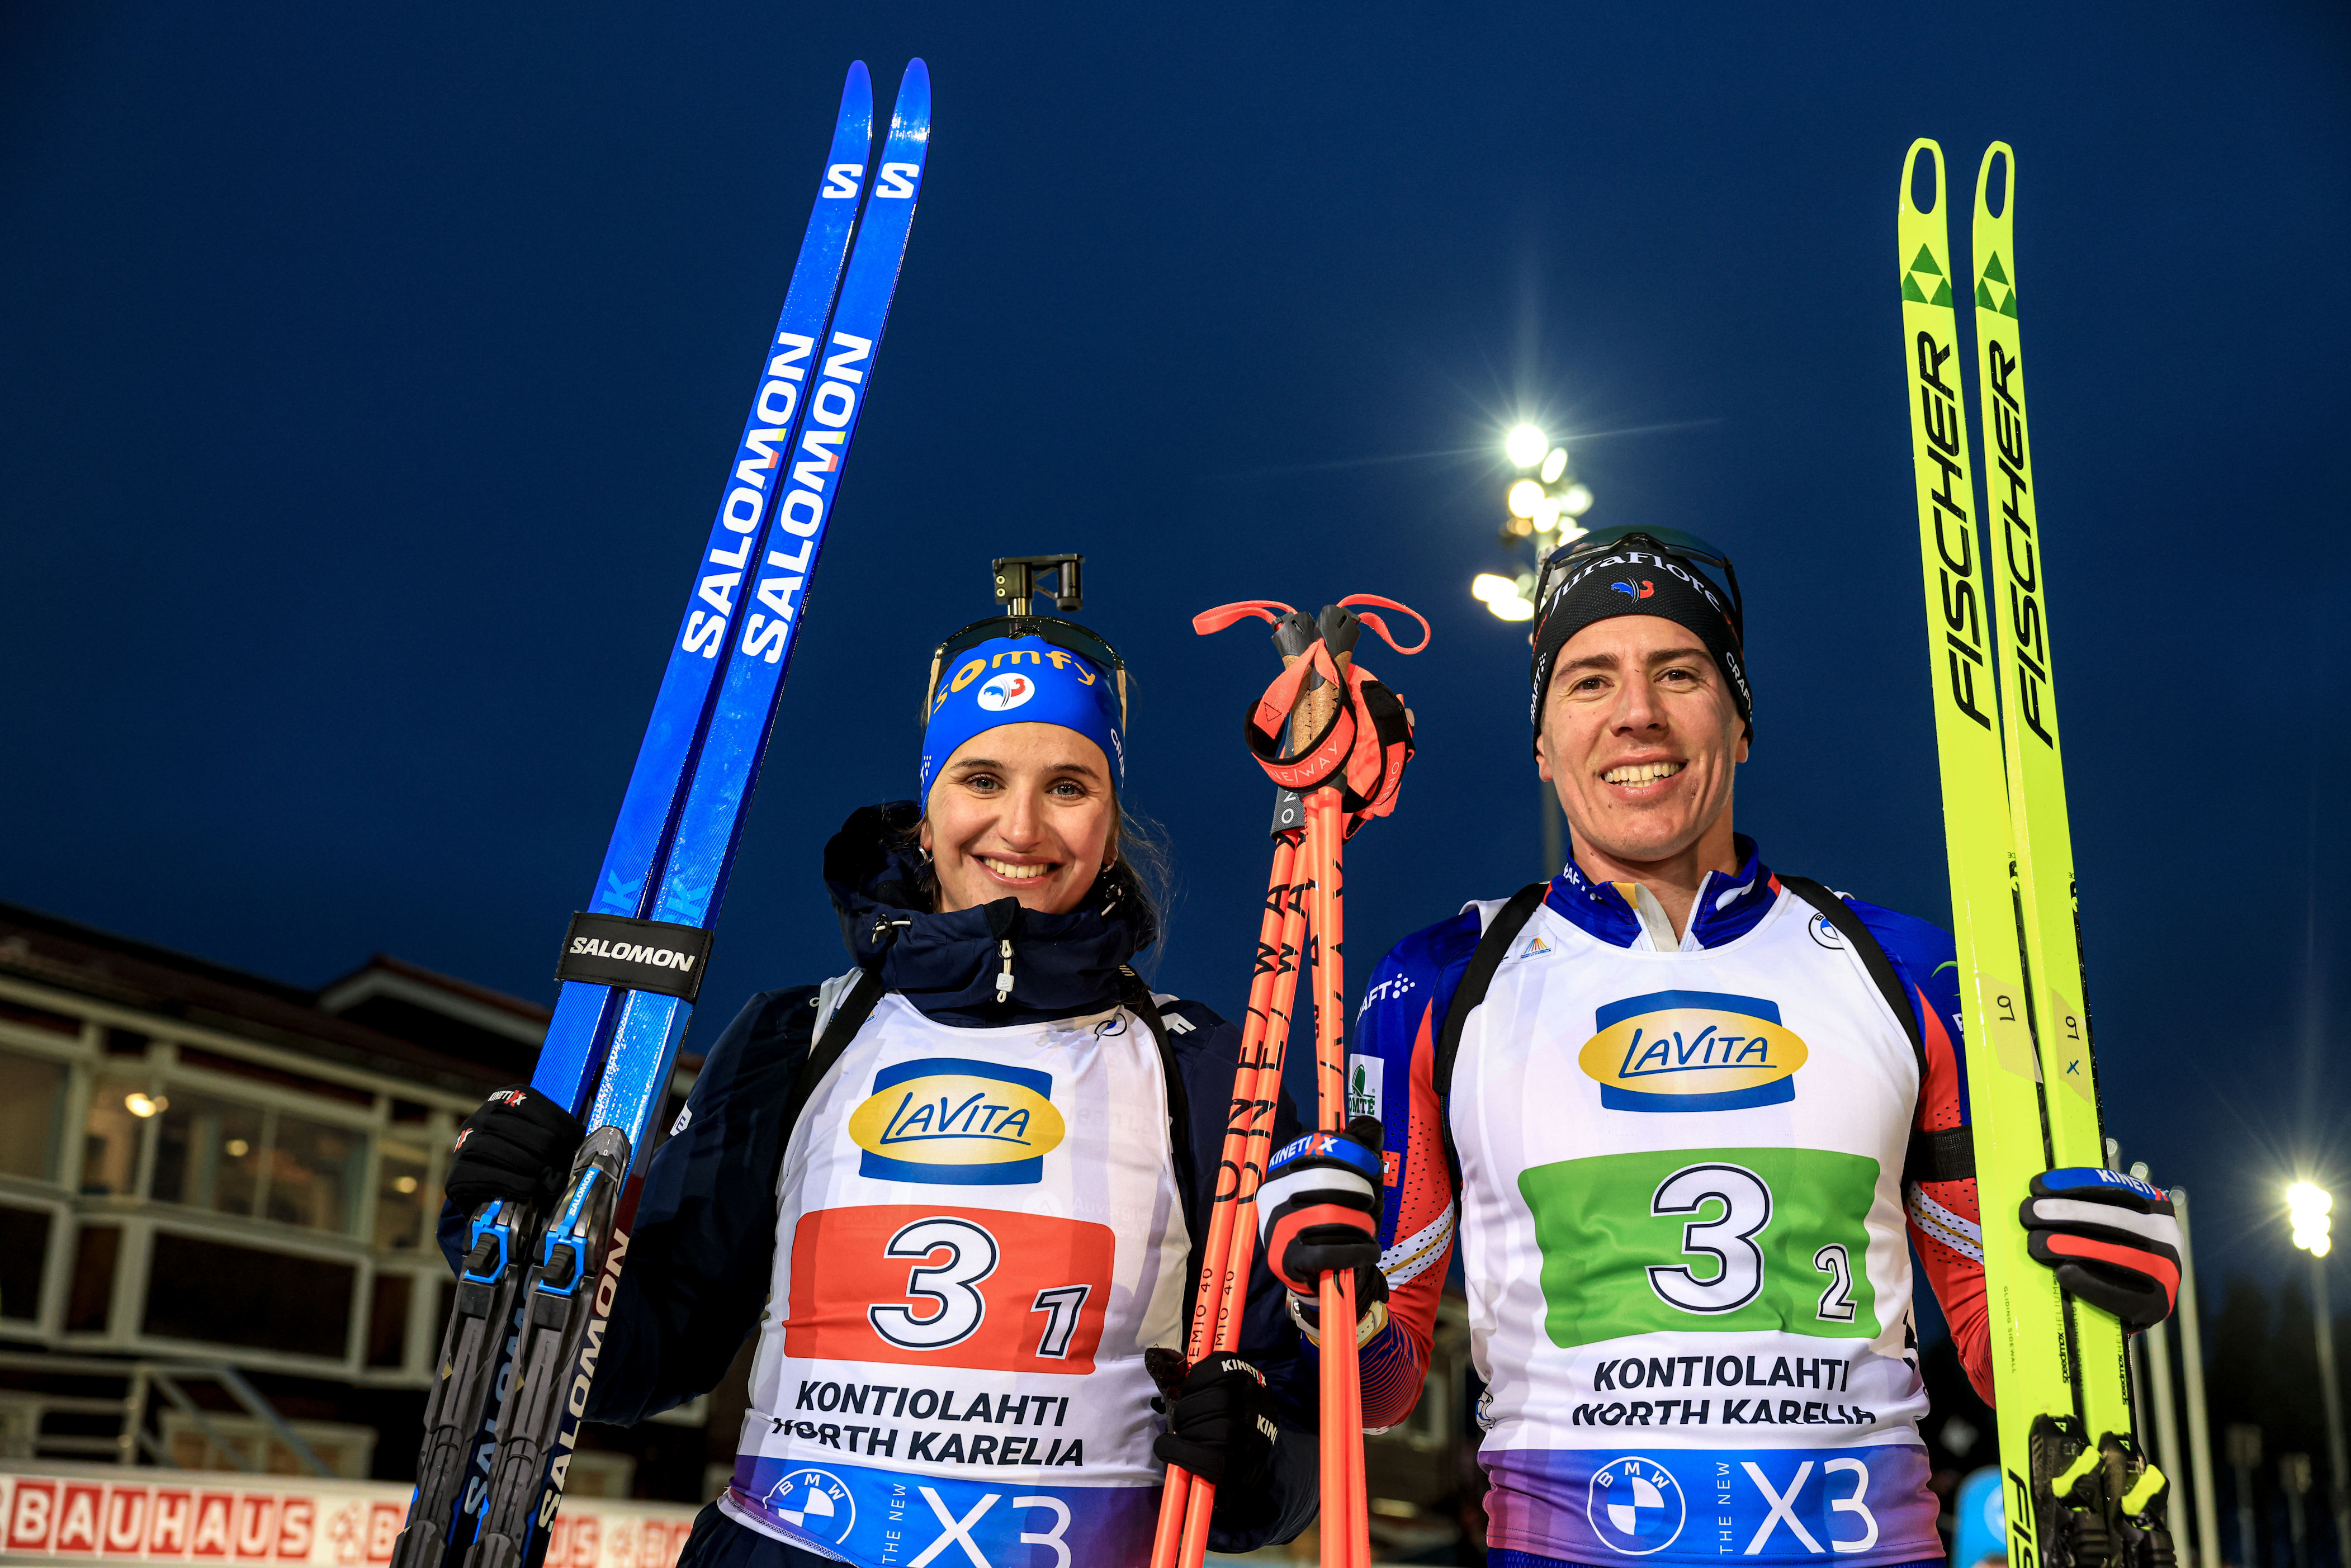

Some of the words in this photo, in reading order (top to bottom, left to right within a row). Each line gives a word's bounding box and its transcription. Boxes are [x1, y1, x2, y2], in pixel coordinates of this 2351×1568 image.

[822, 163, 863, 199] S
[875, 162, 920, 199] S
[682, 331, 815, 659] SALOMON
[741, 331, 873, 664] SALOMON
[1917, 331, 1991, 731] FISCHER
[1989, 339, 2054, 750] FISCHER
[1549, 552, 1721, 617] JuraFlore
[933, 650, 1096, 714] somfy
[1110, 728, 1125, 789] CRAF
[569, 936, 696, 972] SALOMON
[1349, 1098, 1375, 1116] OMTÉ
[569, 1171, 595, 1216] SALOMON
[1644, 1161, 1774, 1315] 3
[1813, 1243, 1858, 1323] 2
[867, 1216, 1000, 1352] 3
[1030, 1284, 1093, 1359] 1
[1187, 1305, 1207, 1367] EMIO
[1200, 1268, 1213, 1293] 40
[1214, 1308, 1228, 1346] MIO
[1224, 1271, 1234, 1296] 40
[2003, 1286, 2012, 1324] GLIDING
[2008, 1327, 2017, 1374] SIDEWALL
[2113, 1318, 2122, 1353] HELIU
[538, 1229, 630, 1533] SALOMON
[795, 1381, 1070, 1427] KONTIOLAHTI
[1593, 1355, 1849, 1392] KONTIOLAHTI
[907, 1431, 1084, 1466] KARELIA
[1597, 1462, 1671, 1490] BMW
[779, 1473, 844, 1501] BMW
[889, 1483, 906, 1522] NEW
[1715, 1461, 1730, 1505] NEW
[1739, 1458, 1880, 1556] X3
[13, 1489, 312, 1555] BAUHAUS
[881, 1530, 902, 1564] THE
[906, 1486, 1072, 1568] X3
[1719, 1514, 1733, 1555] THE
